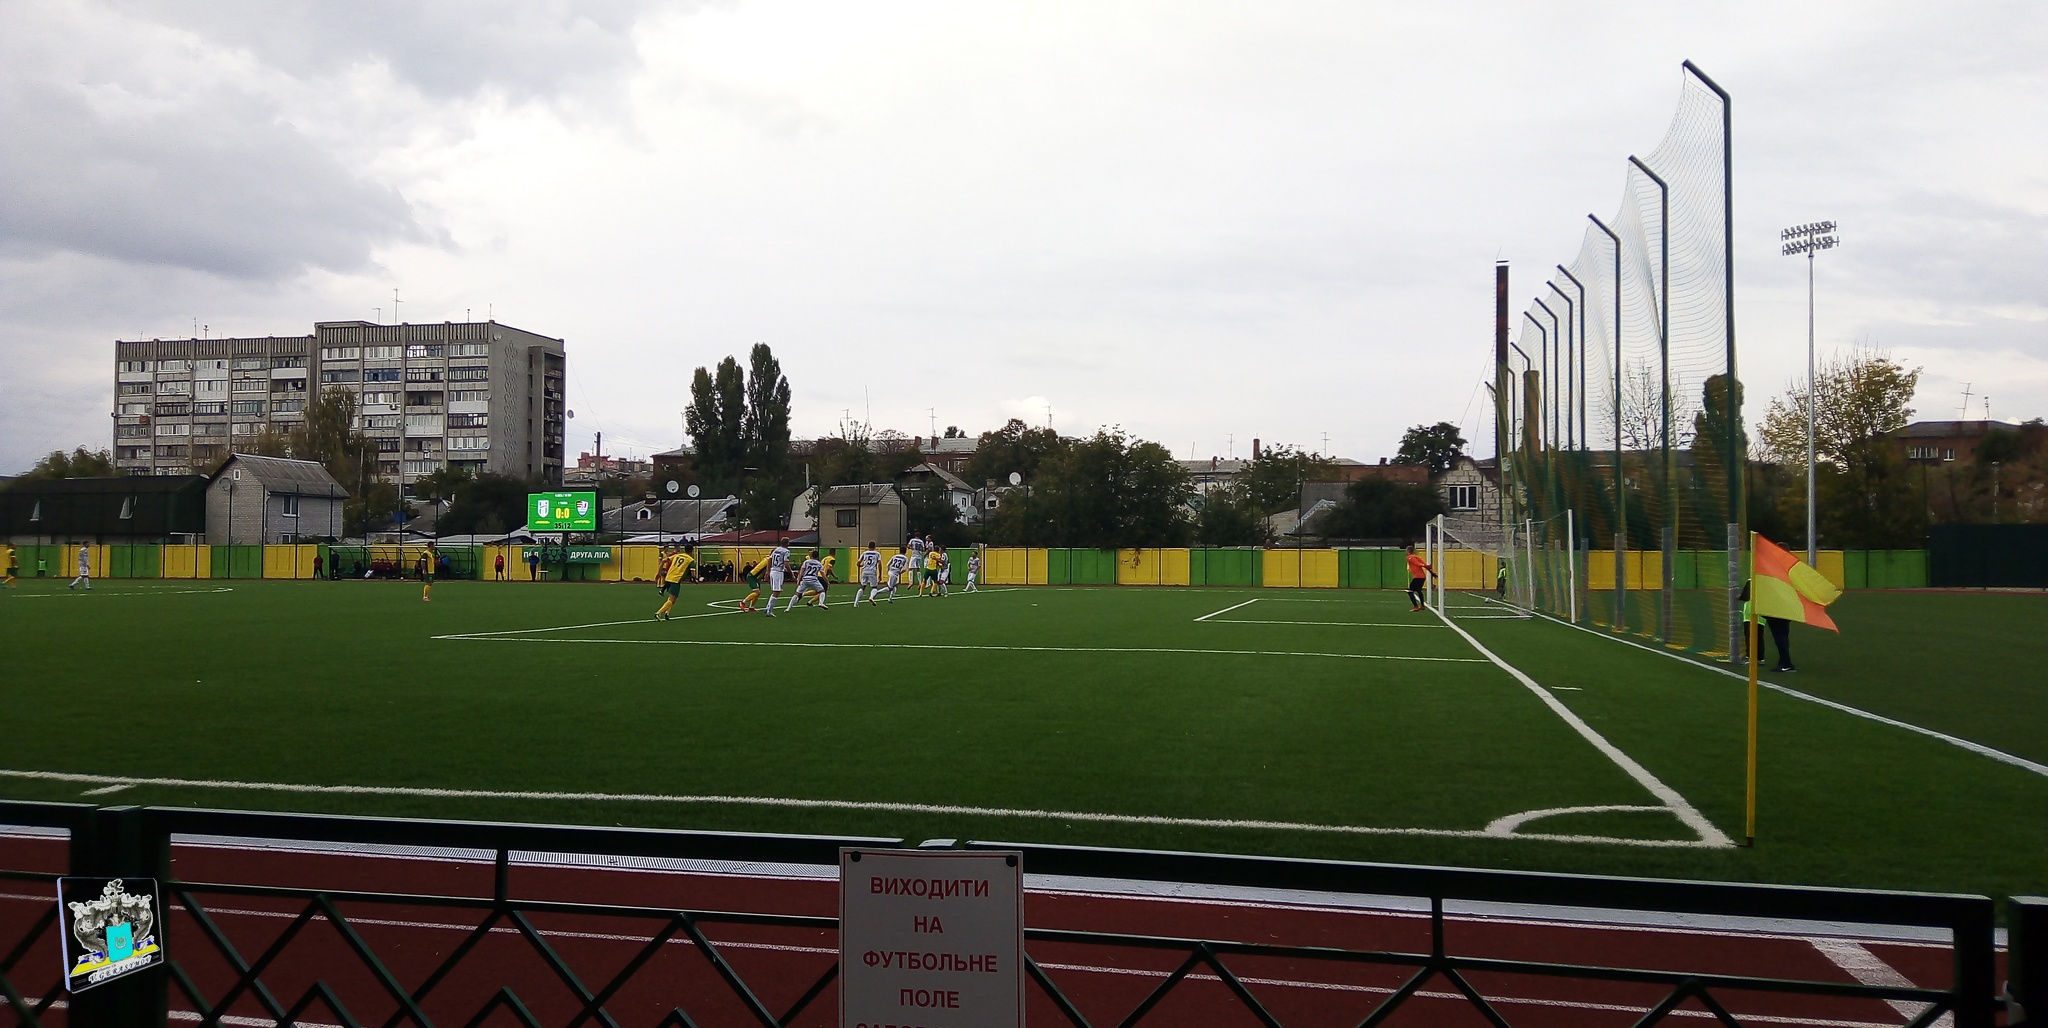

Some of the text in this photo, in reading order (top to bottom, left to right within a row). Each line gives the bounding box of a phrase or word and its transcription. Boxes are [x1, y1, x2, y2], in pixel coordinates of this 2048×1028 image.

[555, 508, 570, 518] 0:0
[570, 551, 610, 559] ДРУГА ЛІГА
[674, 557, 684, 567] 19
[867, 556, 873, 565] 5
[892, 558, 901, 568] 23
[805, 565, 818, 576] 22
[870, 876, 989, 900] ВИХОДИТИ
[913, 916, 944, 933] НА
[862, 950, 998, 973] ФУТБОЛЬНЕ
[900, 988, 960, 1009] ПОЛЕ
